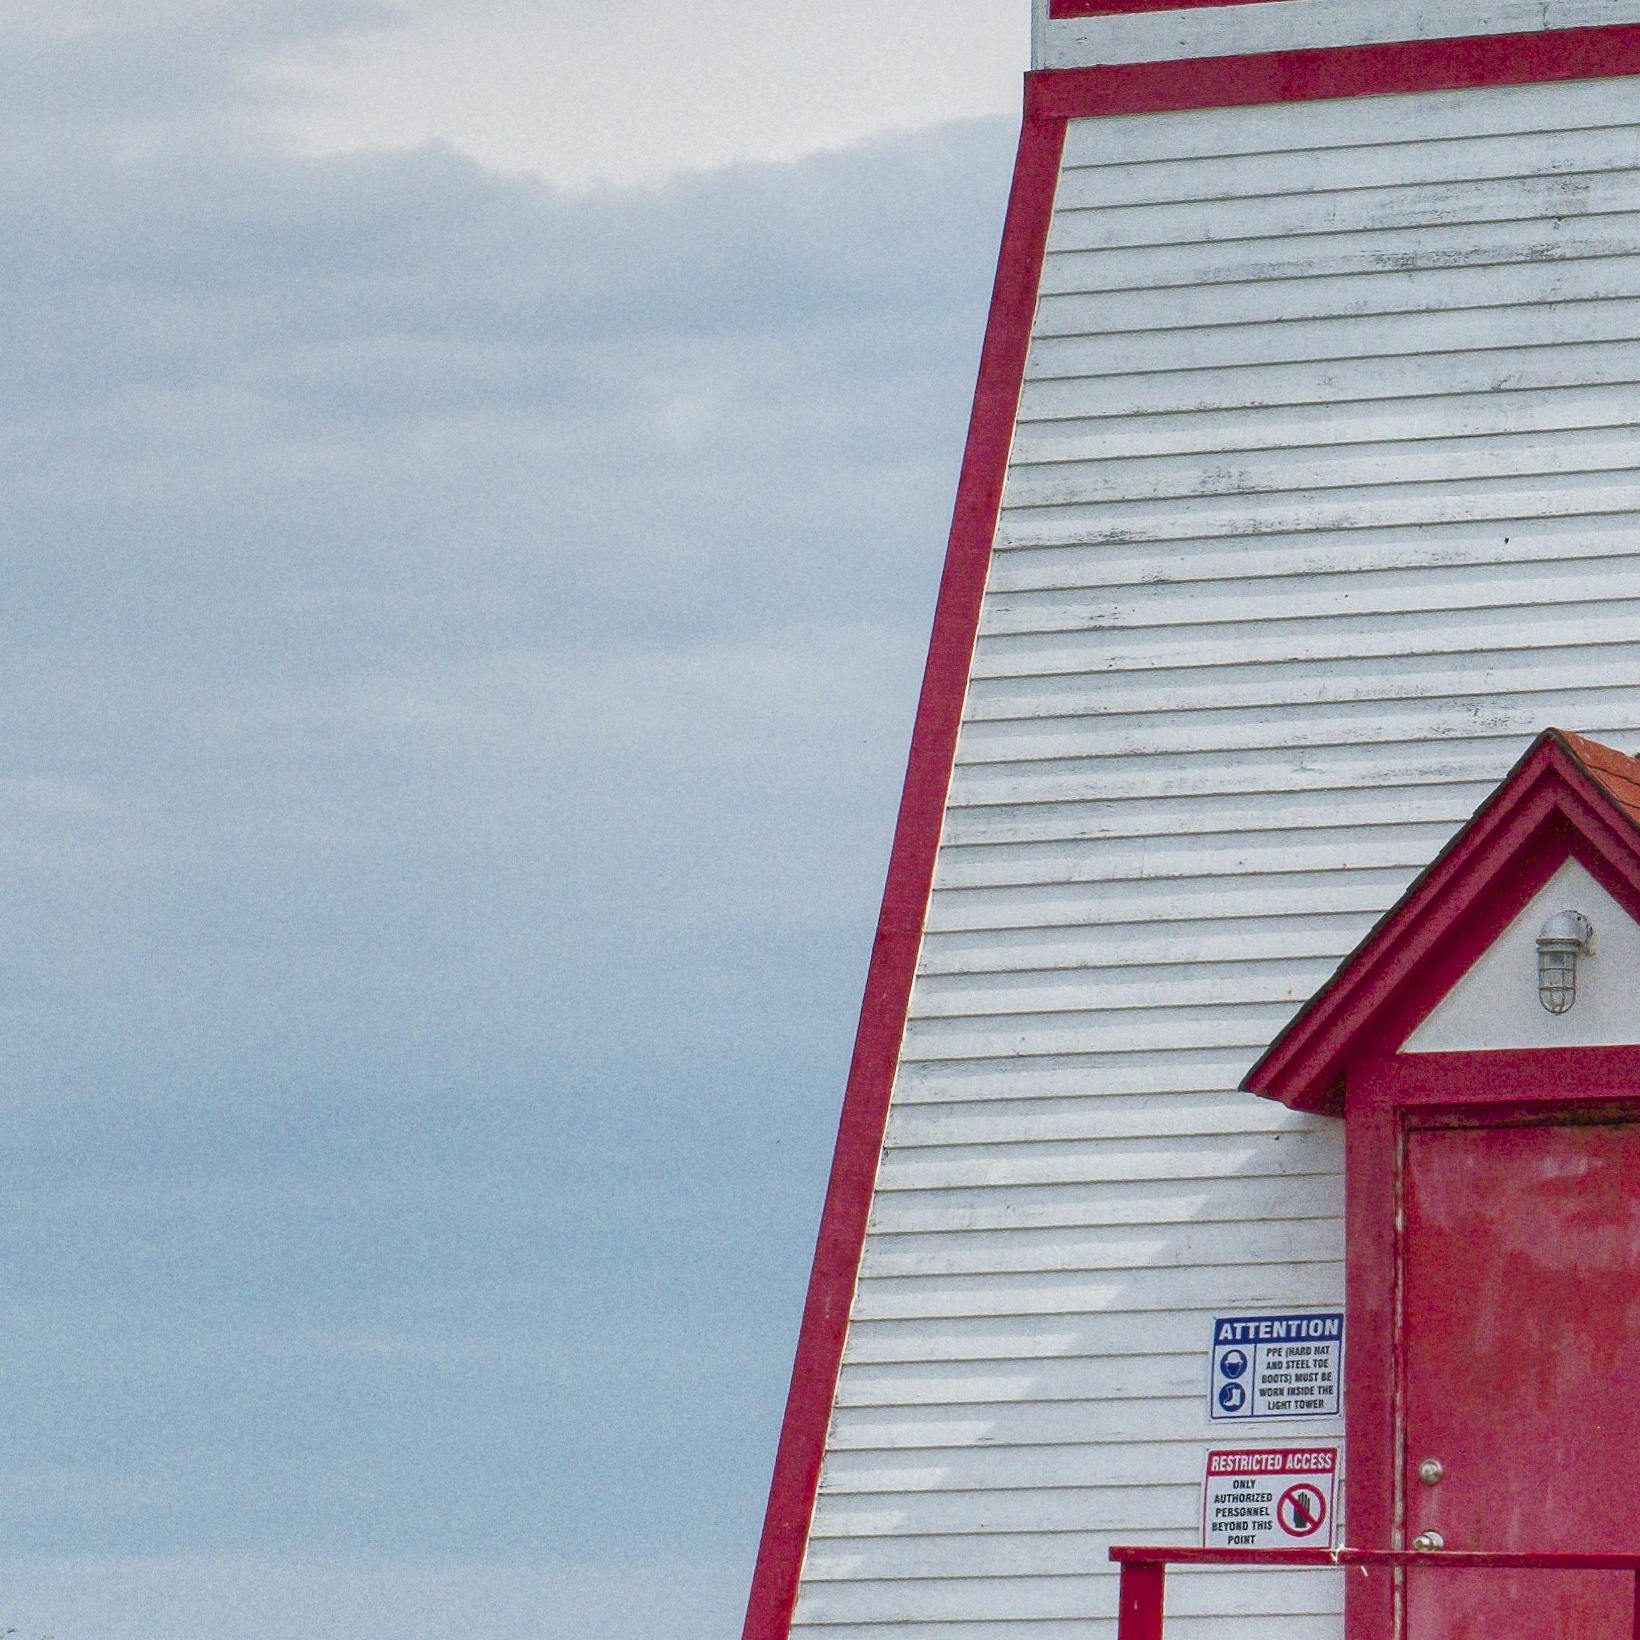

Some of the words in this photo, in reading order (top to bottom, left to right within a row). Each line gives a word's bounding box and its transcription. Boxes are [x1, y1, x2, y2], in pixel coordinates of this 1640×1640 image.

[1219, 1319, 1338, 1340] ATTENTION
[1266, 1348, 1282, 1356] PPE
[1286, 1346, 1311, 1358] (HARD
[1314, 1346, 1330, 1355] HAT
[1266, 1361, 1282, 1370] AND
[1286, 1360, 1310, 1369] STEEL
[1313, 1359, 1328, 1368] TOE
[1262, 1374, 1292, 1384] BOOTS)
[1295, 1373, 1318, 1382] MUST
[1322, 1372, 1332, 1381] BE
[1259, 1388, 1284, 1397] WORN
[1288, 1386, 1314, 1396] INSIDE
[1318, 1386, 1333, 1395] THE
[1268, 1401, 1291, 1410] LIGHT
[1294, 1400, 1324, 1409] TOWER
[1212, 1454, 1282, 1471] RESTRICTED
[1286, 1453, 1332, 1469] ACCESS
[1233, 1480, 1256, 1489] ONLY
[1214, 1493, 1272, 1503] AUTHORIZED
[1216, 1507, 1270, 1517] PERSONNEL
[1212, 1522, 1248, 1531] BEYOND
[1252, 1521, 1272, 1530] THIS
[1228, 1535, 1256, 1544] POINT
